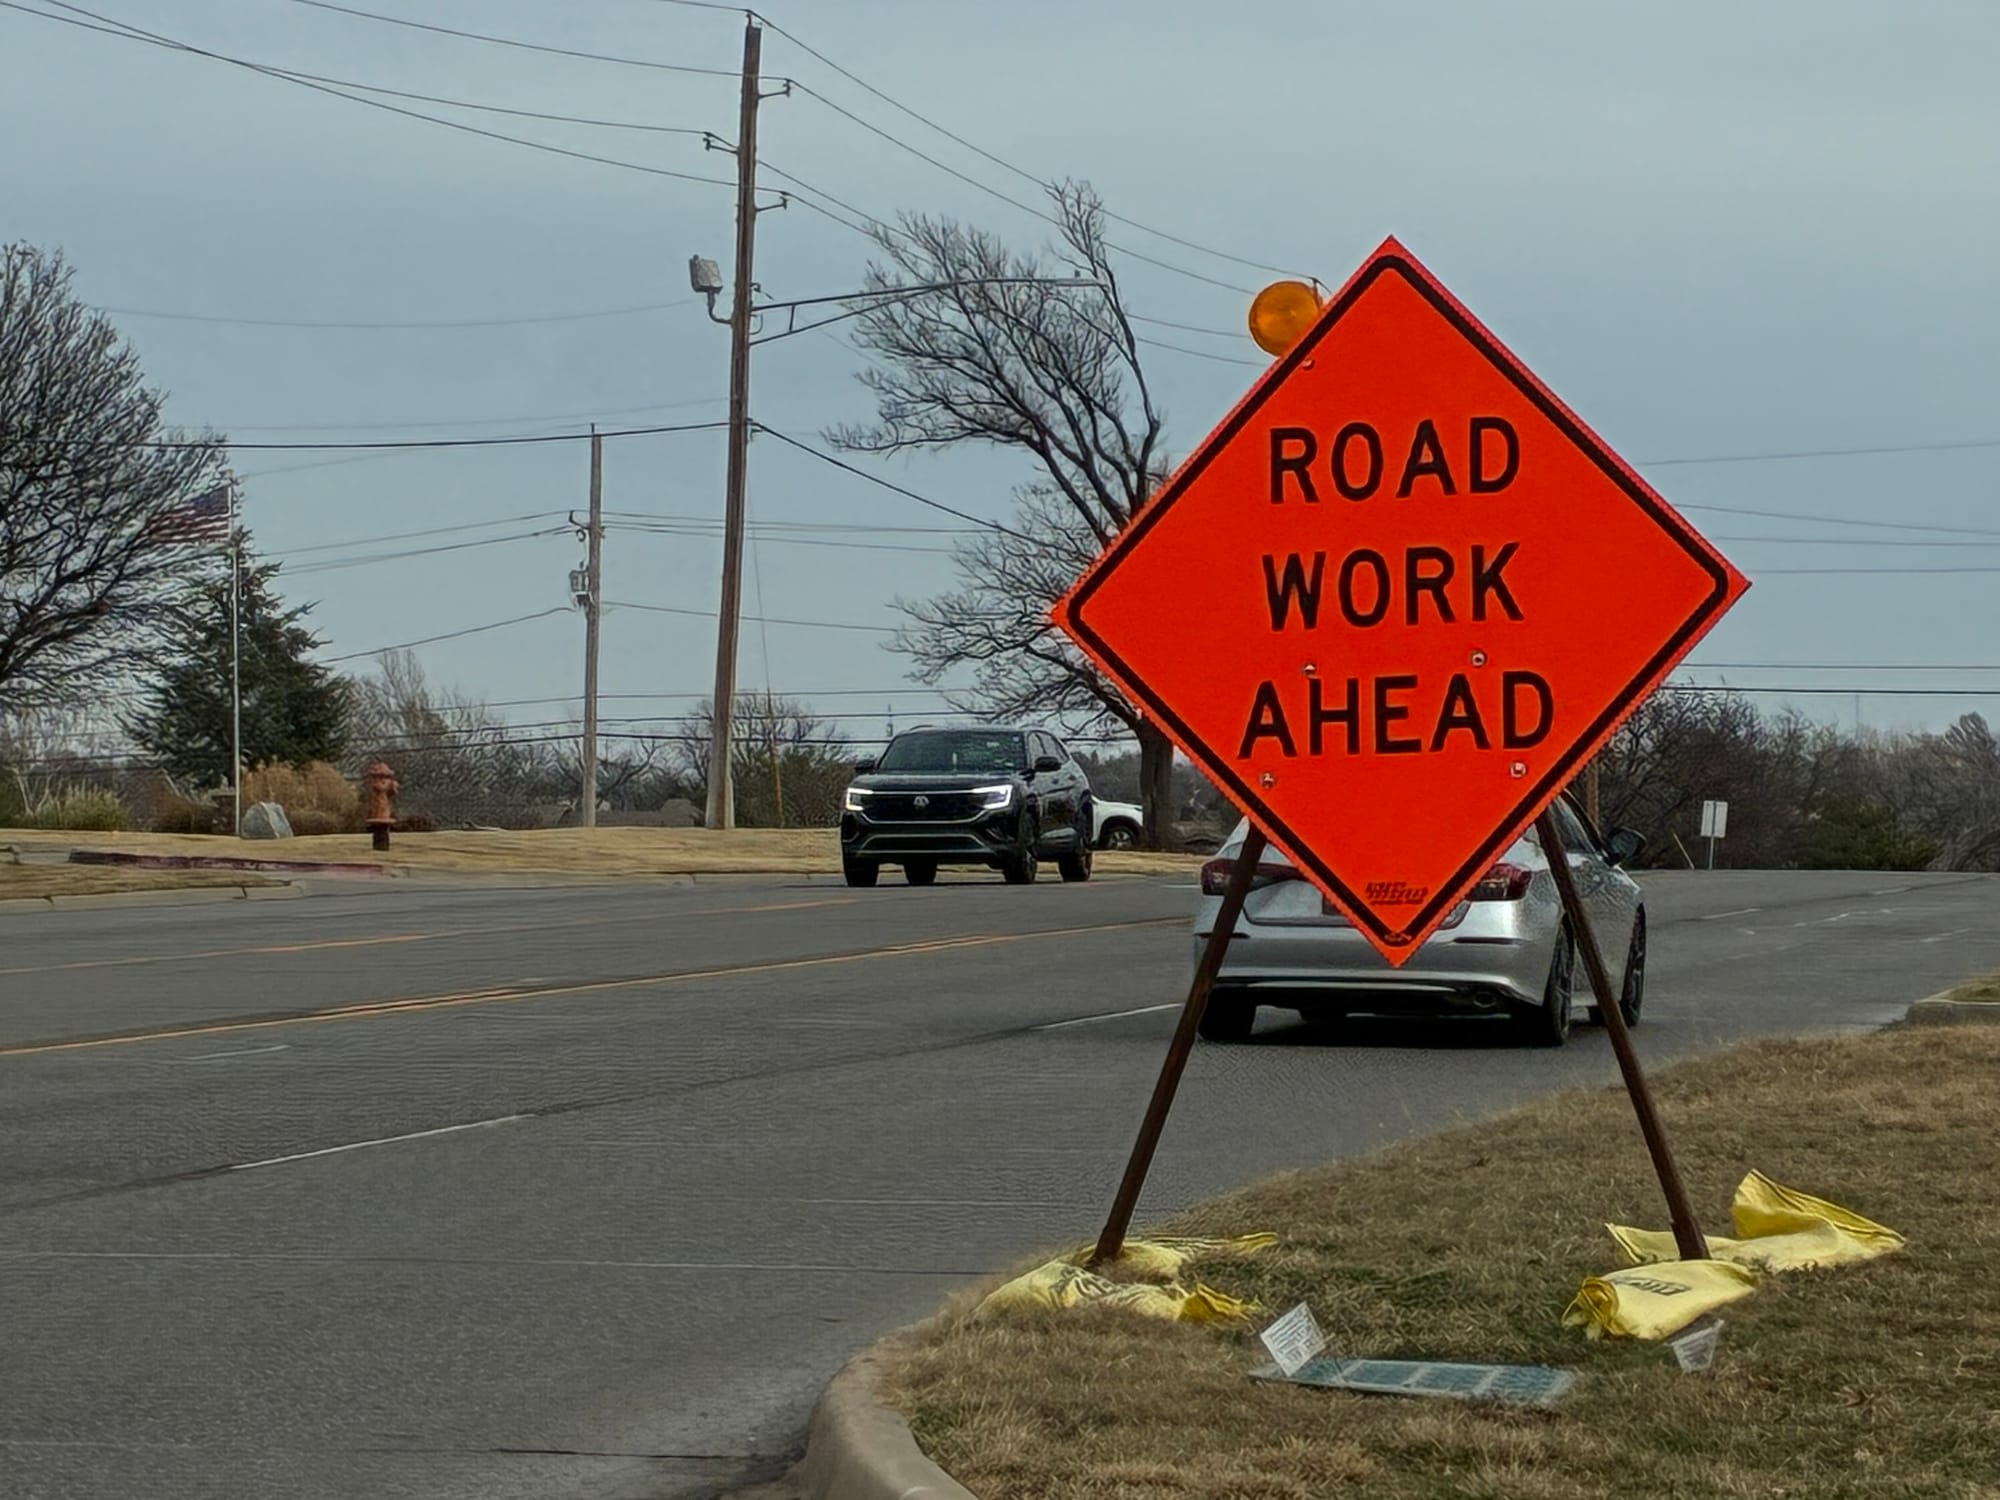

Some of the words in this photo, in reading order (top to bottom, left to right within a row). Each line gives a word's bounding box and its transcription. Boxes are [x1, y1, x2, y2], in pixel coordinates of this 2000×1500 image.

[1270, 416, 1520, 504] ROAD
[1262, 542, 1523, 631] WORK
[1238, 670, 1554, 759] AHEAD
